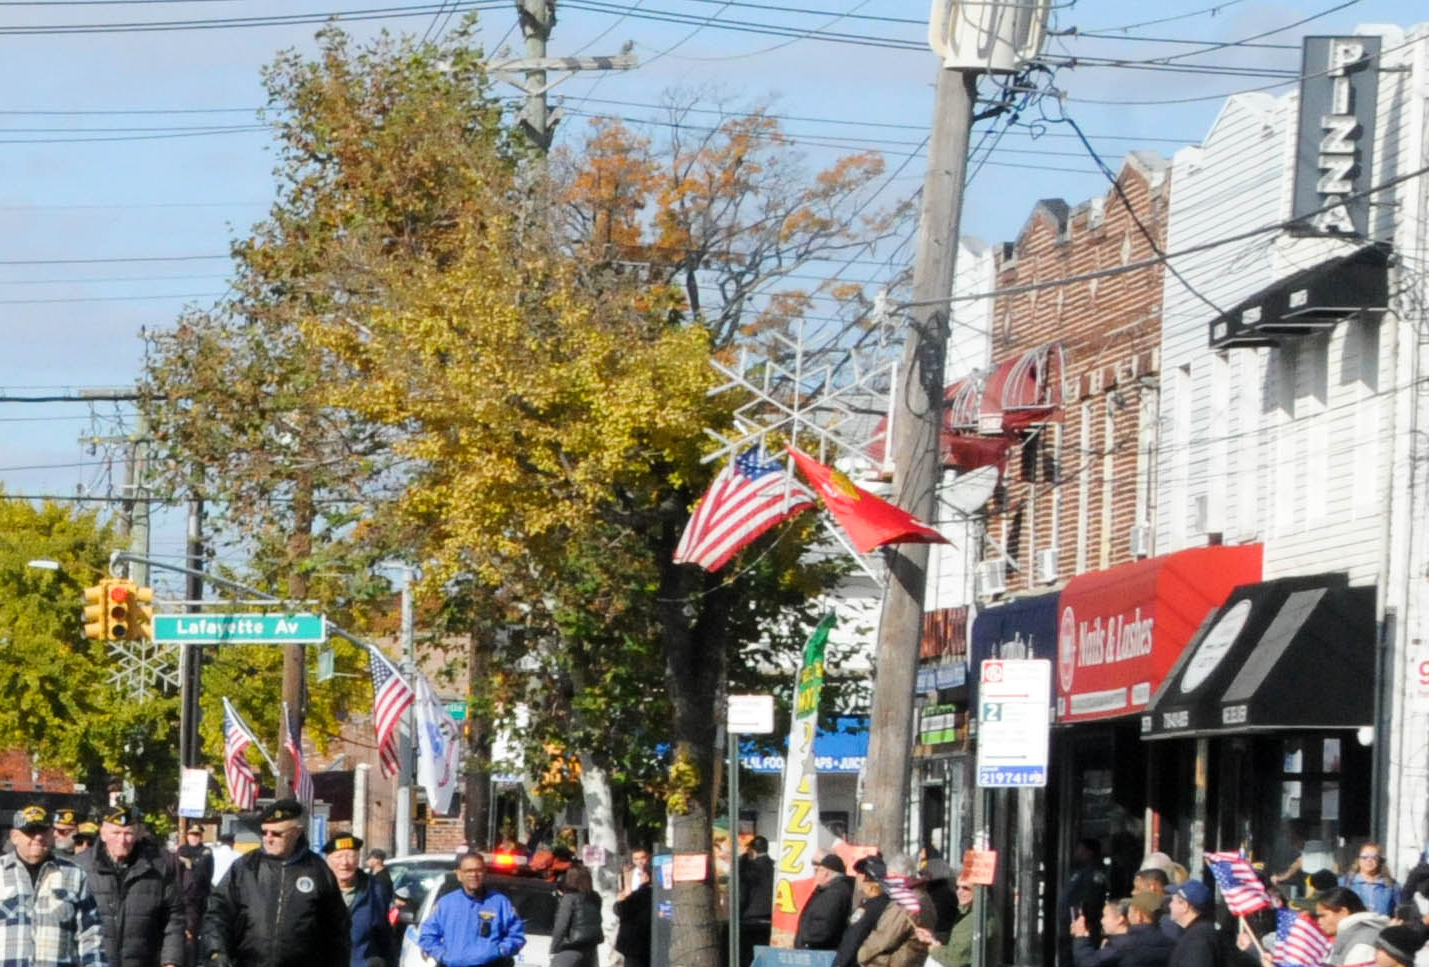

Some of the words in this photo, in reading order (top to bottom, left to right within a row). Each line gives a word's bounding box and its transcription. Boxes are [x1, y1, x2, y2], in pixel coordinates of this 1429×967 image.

[1314, 38, 1364, 232] PIZZA
[177, 619, 264, 637] Lafayette
[274, 619, 298, 634] Av
[1078, 616, 1105, 667] Nails
[1105, 616, 1116, 664] &
[1116, 608, 1154, 662] Lashes
[986, 704, 999, 721] 2
